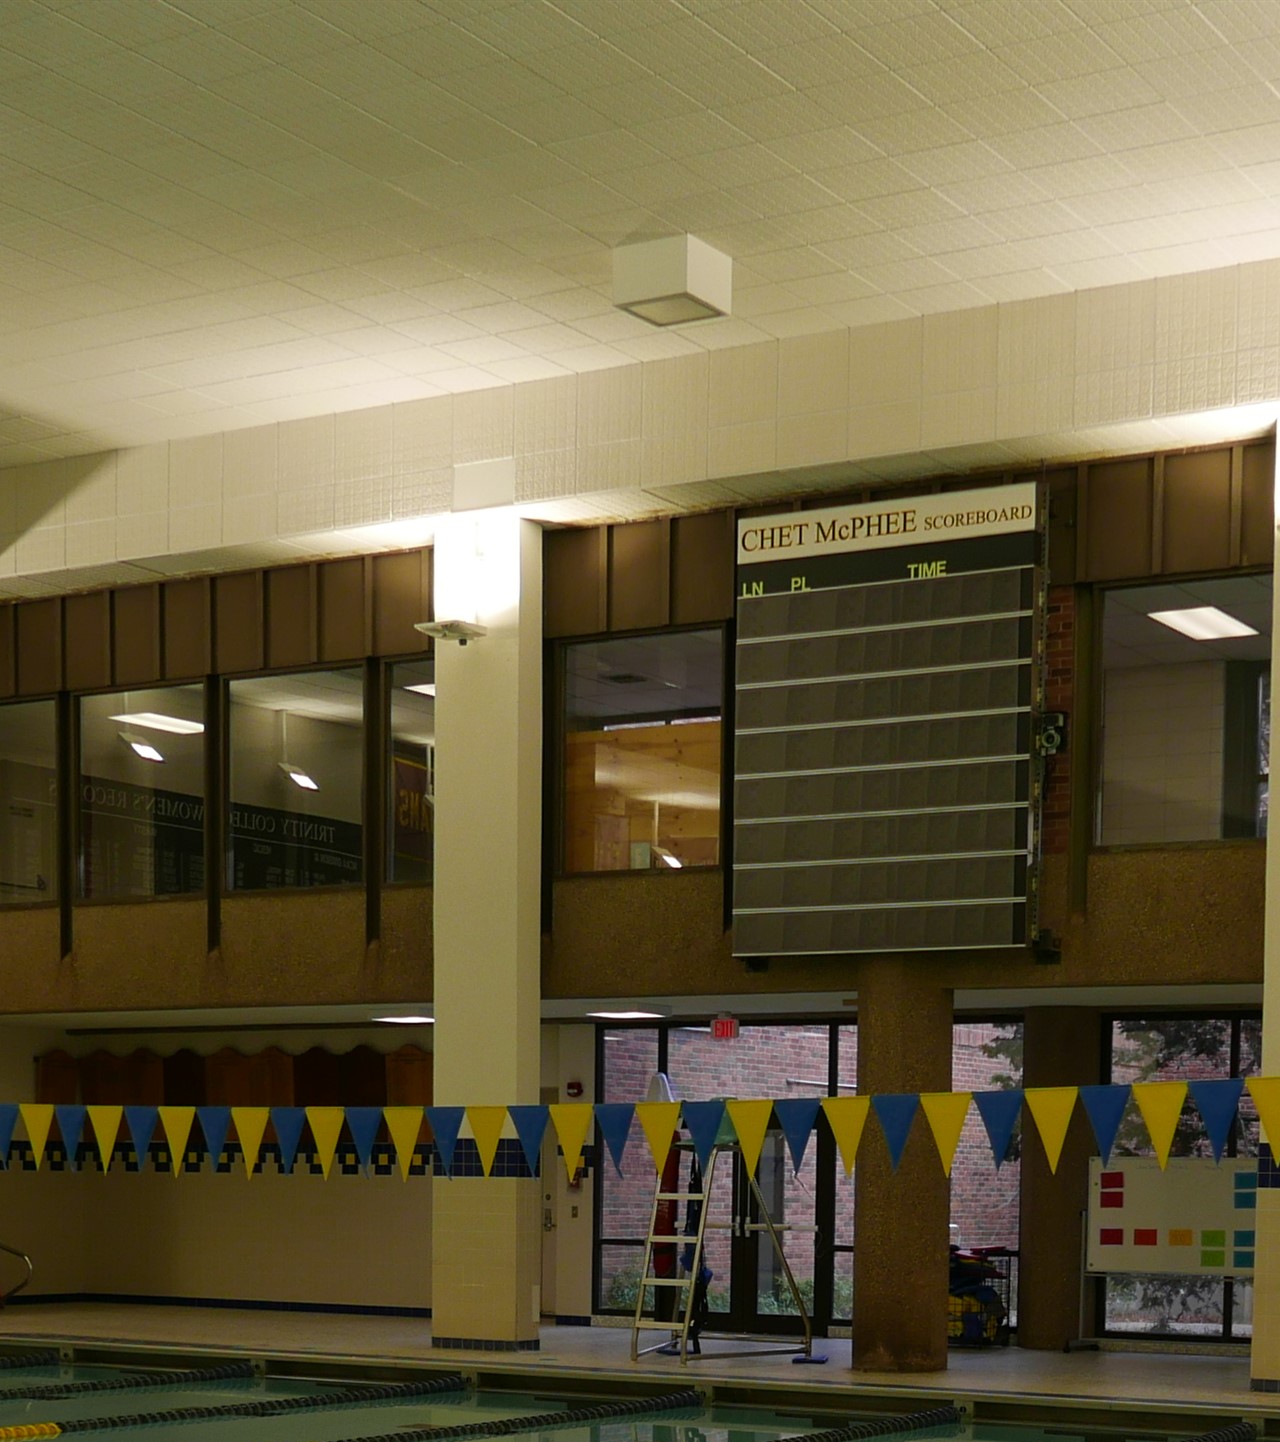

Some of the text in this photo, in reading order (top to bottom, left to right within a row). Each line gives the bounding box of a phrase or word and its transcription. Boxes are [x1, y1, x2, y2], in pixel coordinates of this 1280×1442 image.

[741, 505, 1032, 552] CHET McPHEE SCOREBOARD
[742, 561, 947, 597] LN PL TIME
